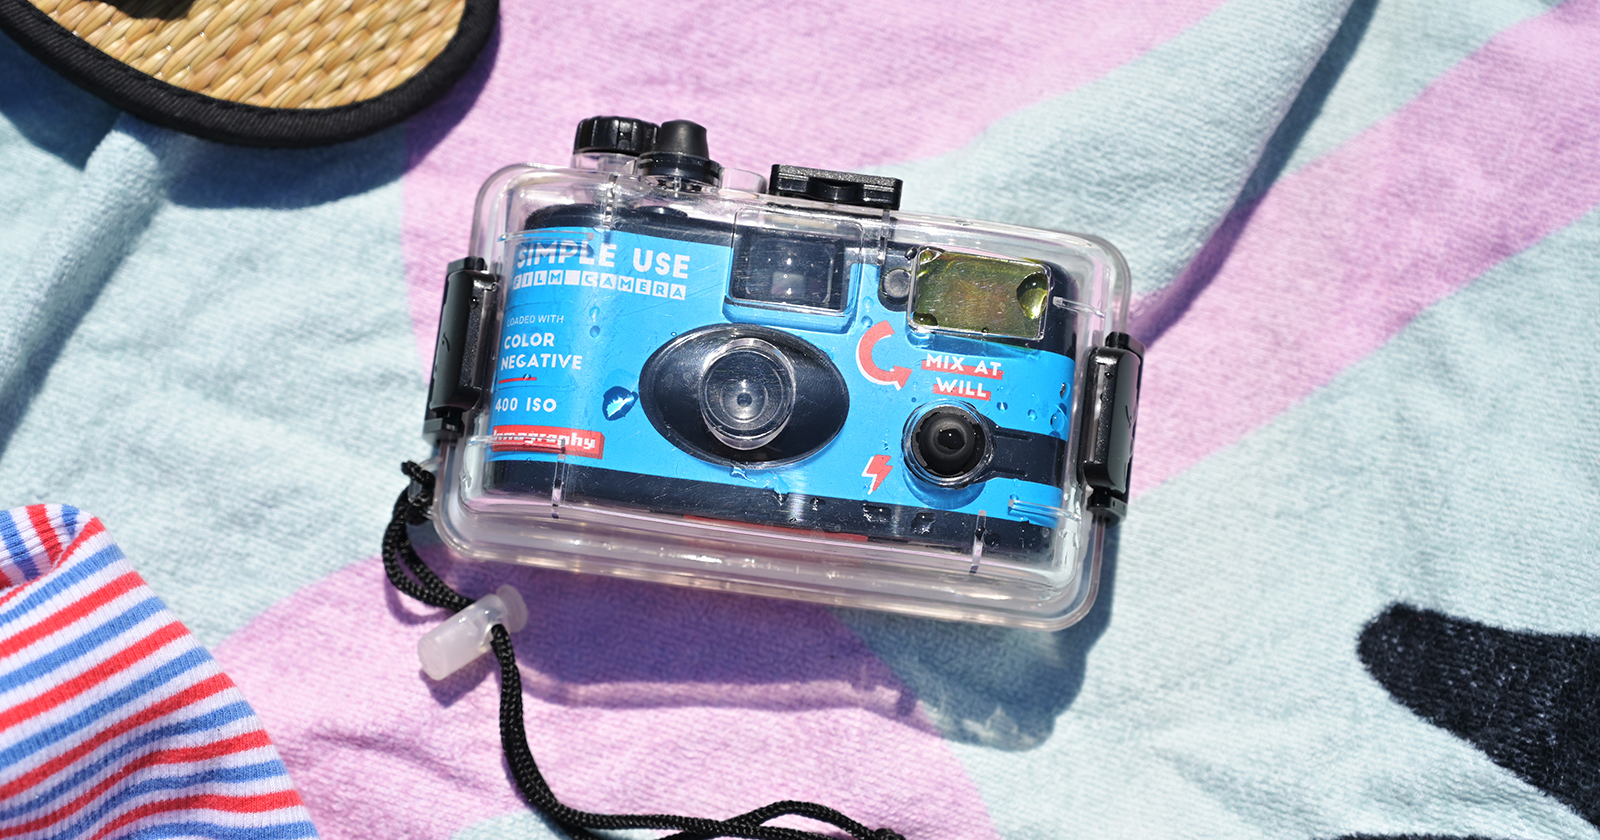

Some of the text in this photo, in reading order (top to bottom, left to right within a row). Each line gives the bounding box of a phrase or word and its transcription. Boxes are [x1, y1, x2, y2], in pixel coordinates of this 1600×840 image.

[517, 240, 690, 279] SIMPLE USE
[513, 270, 686, 300] FILM CAMERA
[506, 314, 564, 328] LOADED WITH
[504, 332, 555, 350] COLOR
[500, 353, 583, 371] NEGATIVE
[925, 353, 1001, 376] MIX AT
[935, 377, 987, 398] WILL
[495, 397, 557, 412] 400 ISO
